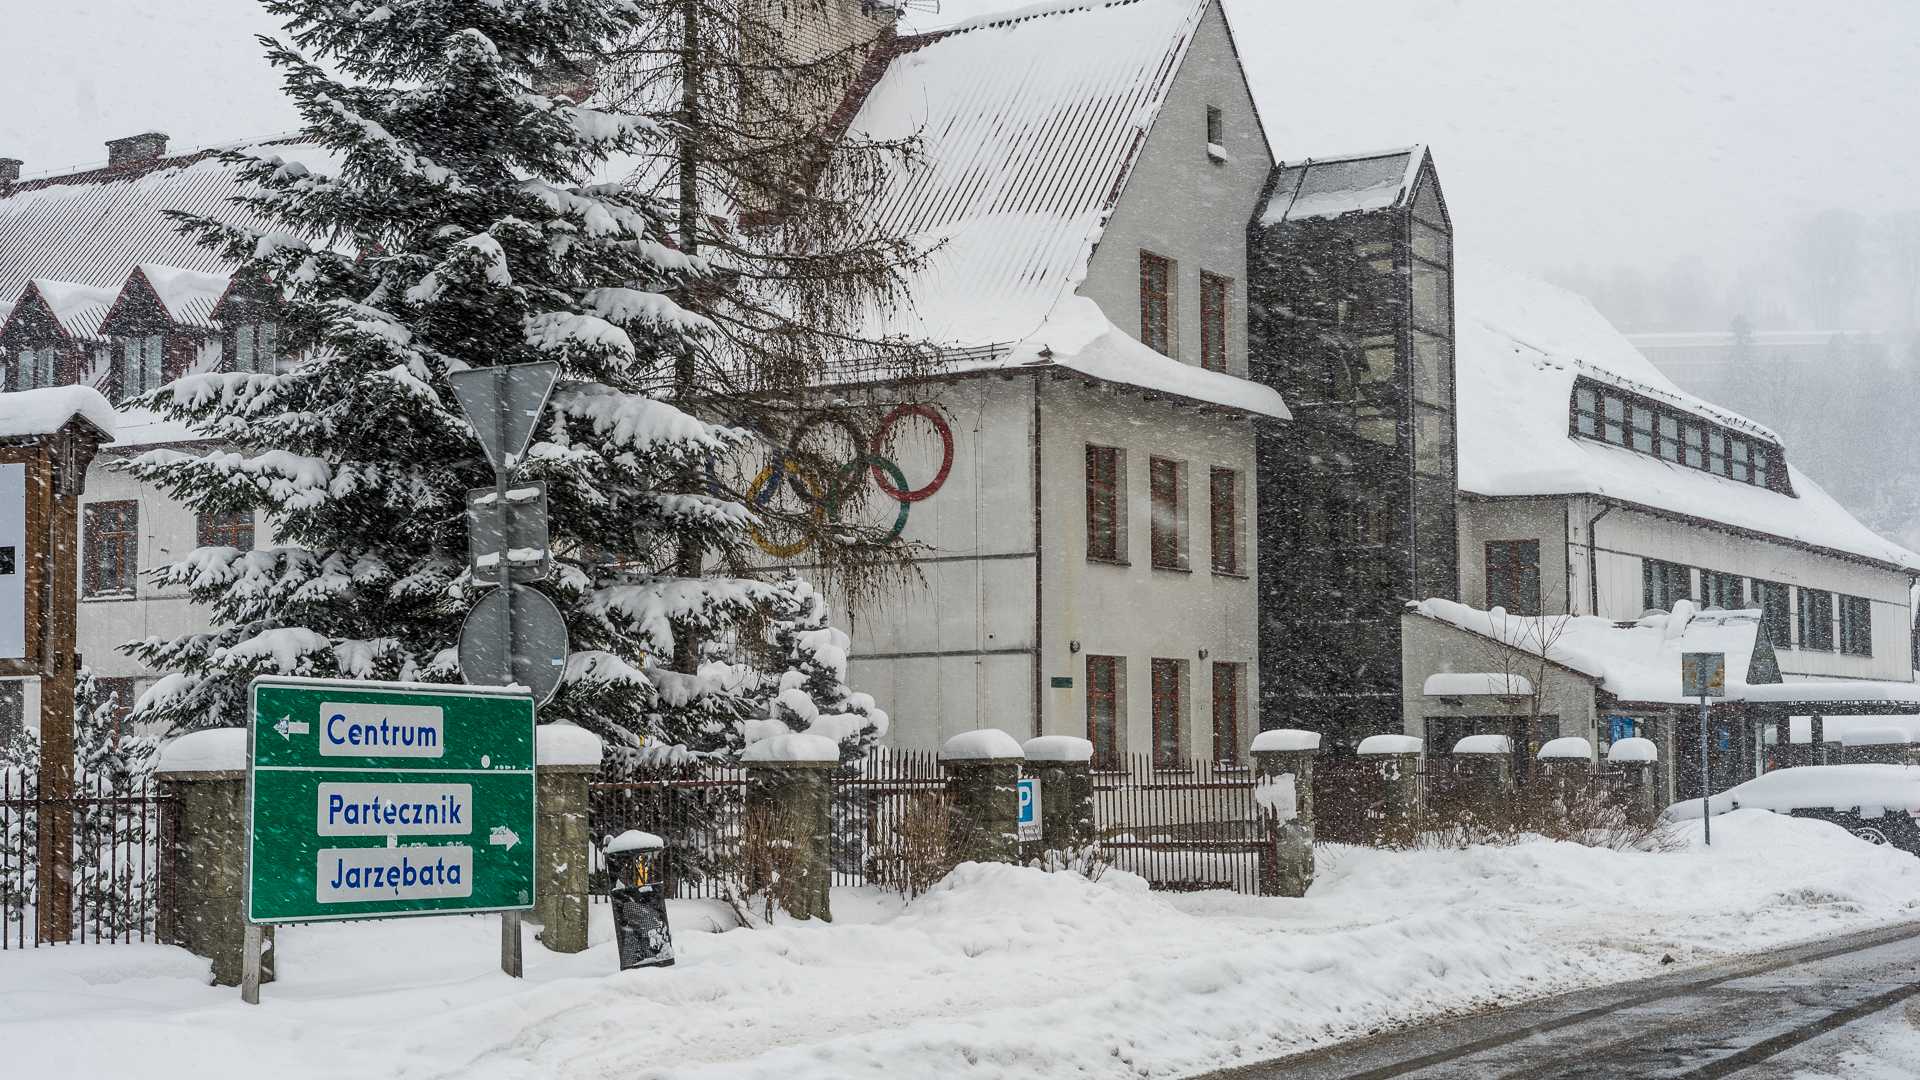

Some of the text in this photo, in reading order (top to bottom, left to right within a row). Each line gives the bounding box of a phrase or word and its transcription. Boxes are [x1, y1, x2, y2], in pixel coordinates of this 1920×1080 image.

[327, 714, 437, 747] Centrum
[329, 794, 461, 825] Partecznik
[1018, 785, 1031, 819] P
[331, 857, 461, 896] Jarzębata
